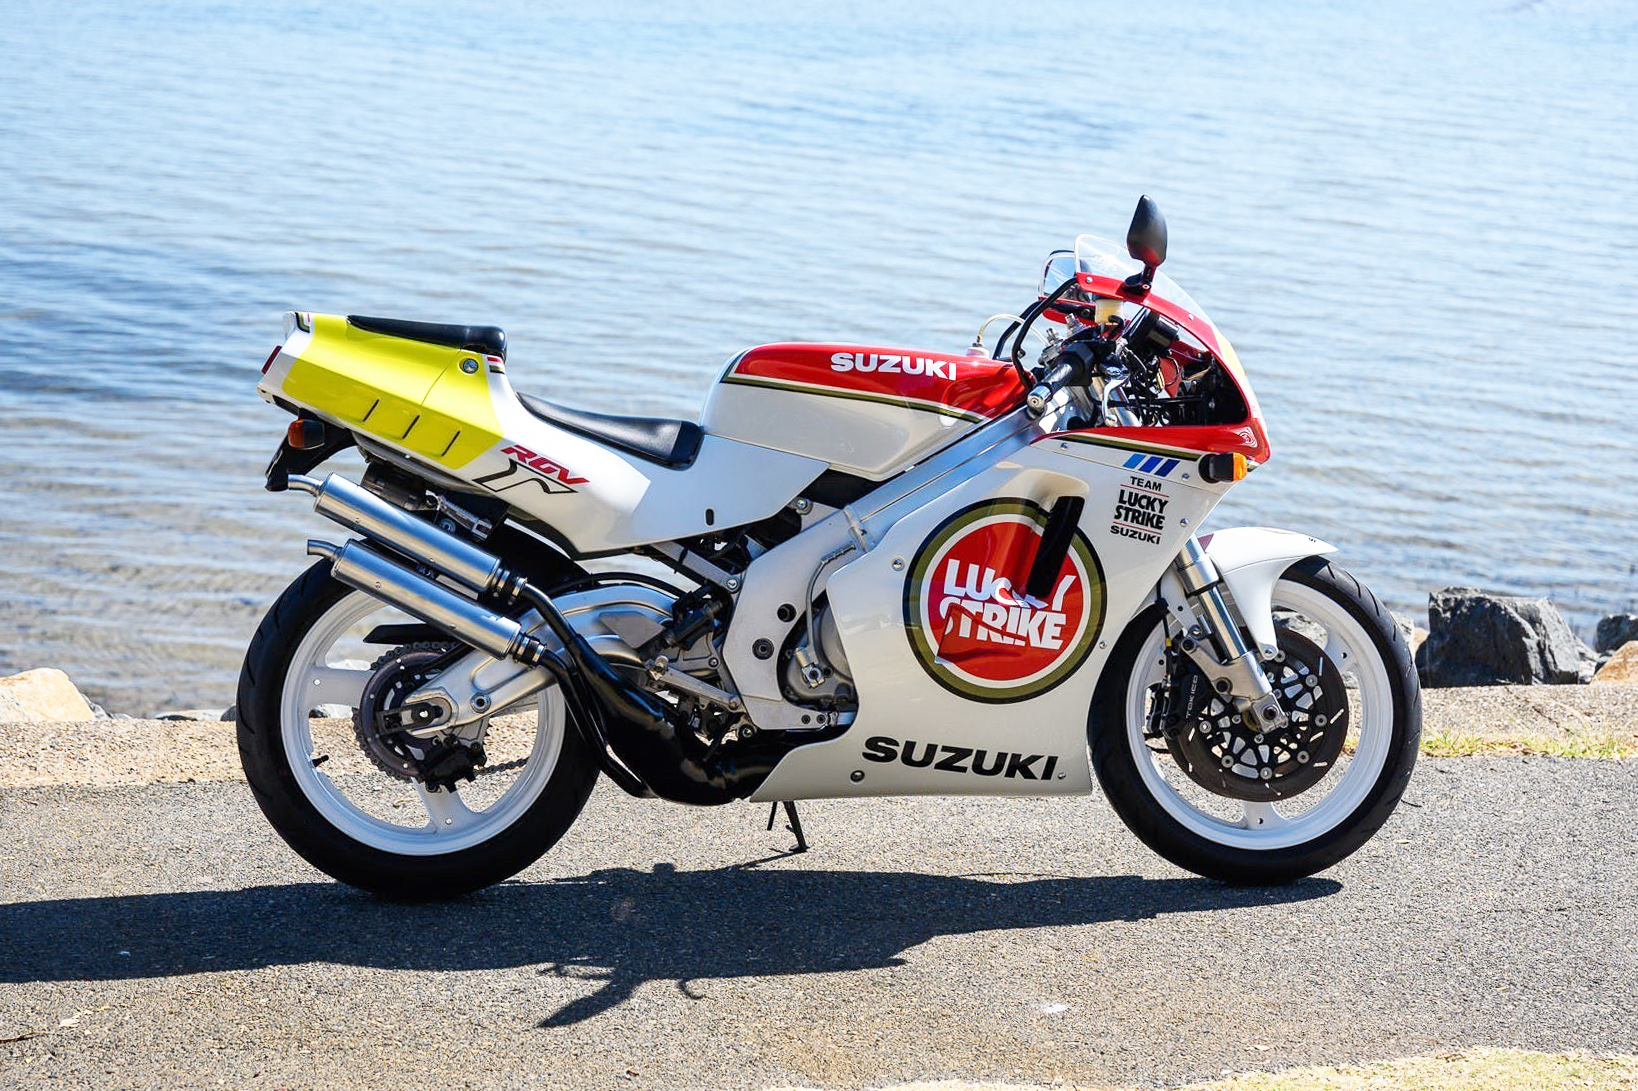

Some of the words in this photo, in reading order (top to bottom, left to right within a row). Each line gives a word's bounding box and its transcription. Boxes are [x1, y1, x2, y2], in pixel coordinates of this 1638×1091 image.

[830, 352, 957, 381] SUZUKI
[500, 444, 591, 485] RGV
[1130, 476, 1162, 492] TEAM
[1118, 489, 1169, 514] LUCKY
[1114, 505, 1166, 530] STRIKE
[1110, 525, 1161, 545] SUZUKI
[1186, 674, 1199, 719] TOKICO
[861, 736, 1058, 780] SUZUKI
